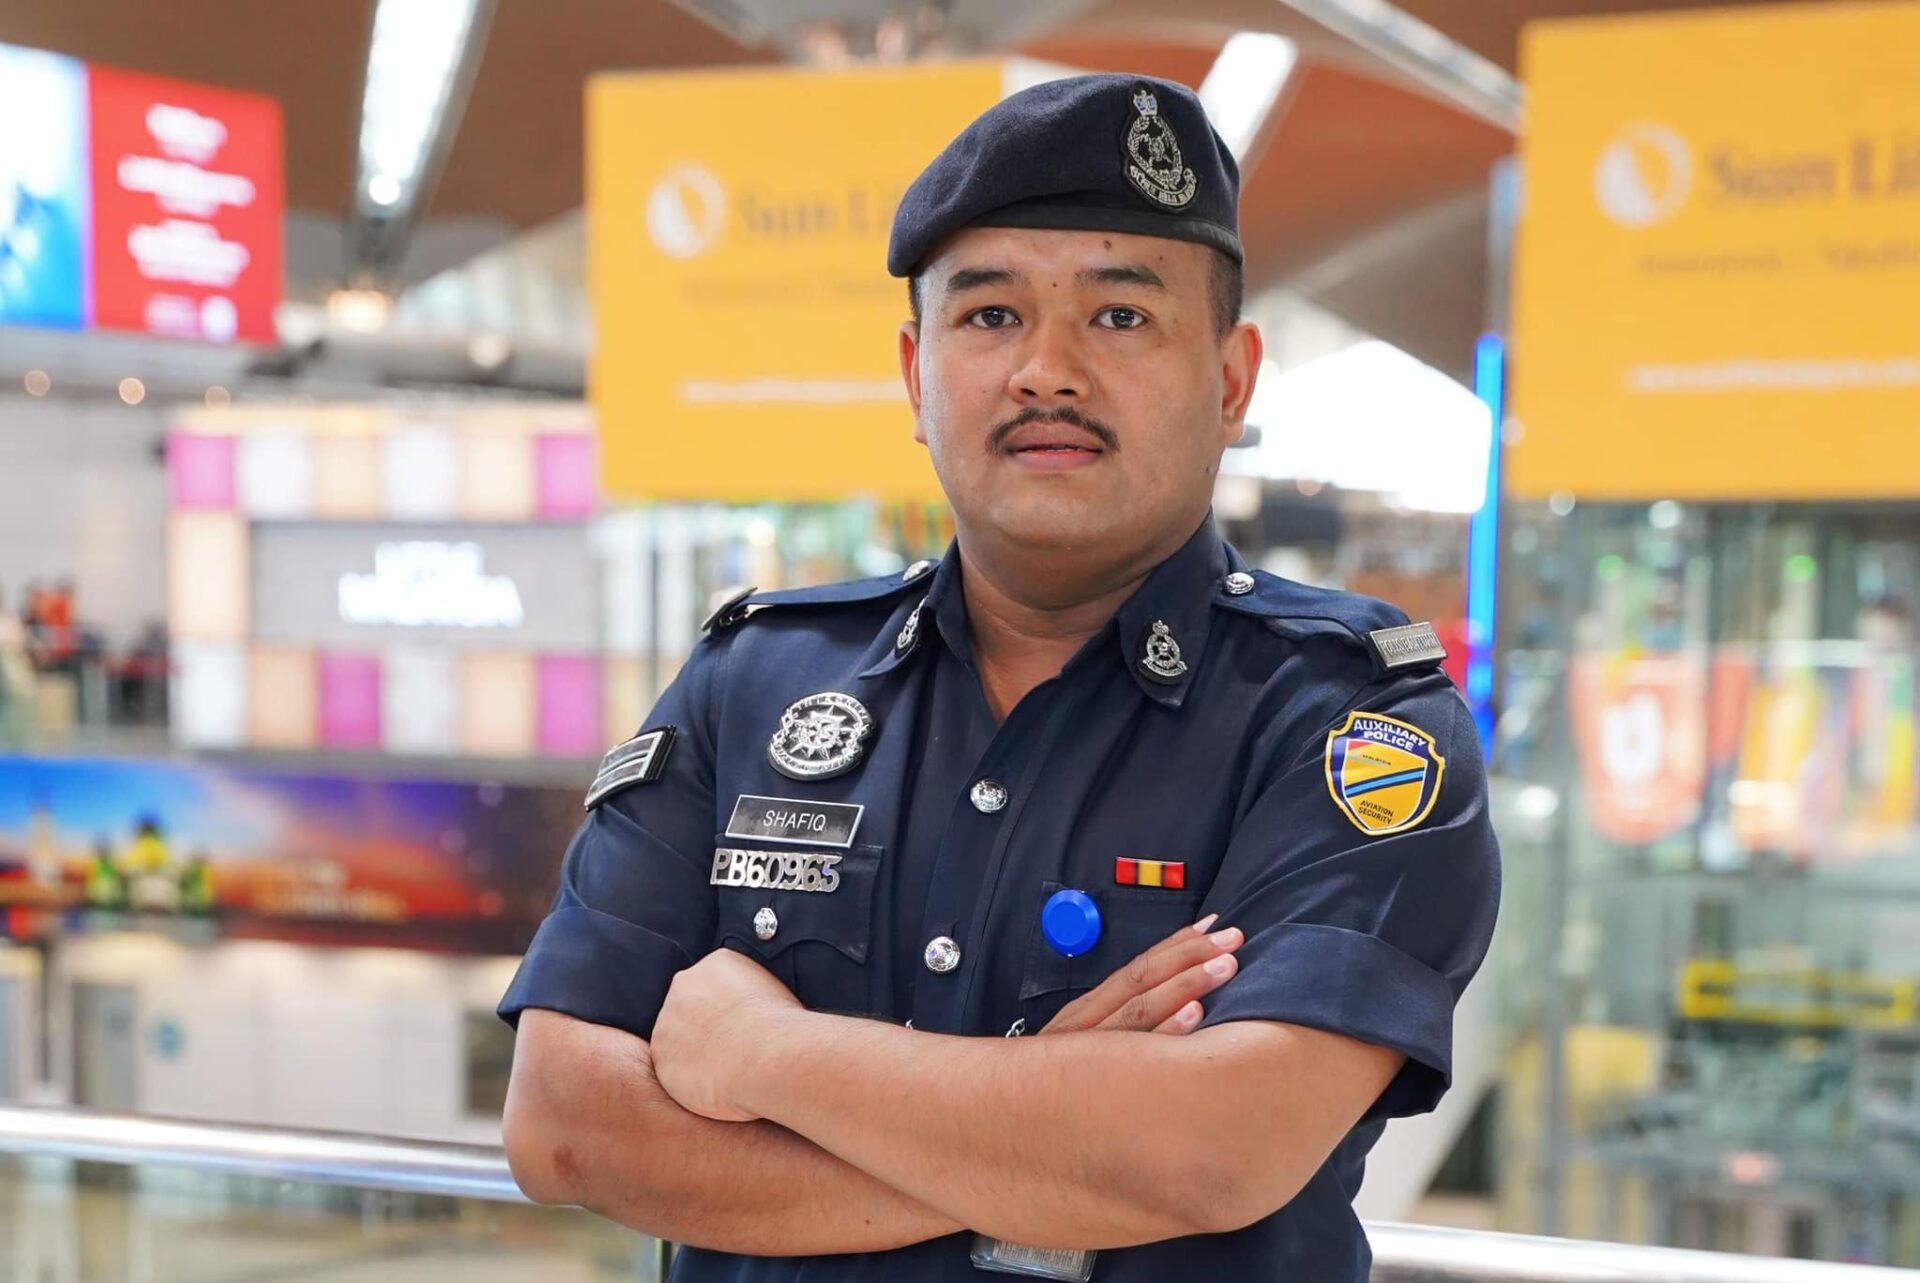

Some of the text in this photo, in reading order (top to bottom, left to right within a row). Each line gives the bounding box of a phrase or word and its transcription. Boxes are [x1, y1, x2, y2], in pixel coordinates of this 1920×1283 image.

[1353, 719, 1427, 746] AUXILIARY
[1363, 731, 1414, 752] POLICE
[1358, 806, 1393, 825] SECURITY
[1360, 800, 1394, 817] AVIATION
[763, 809, 826, 832] SHAFIQ
[710, 848, 843, 892] PB60965
